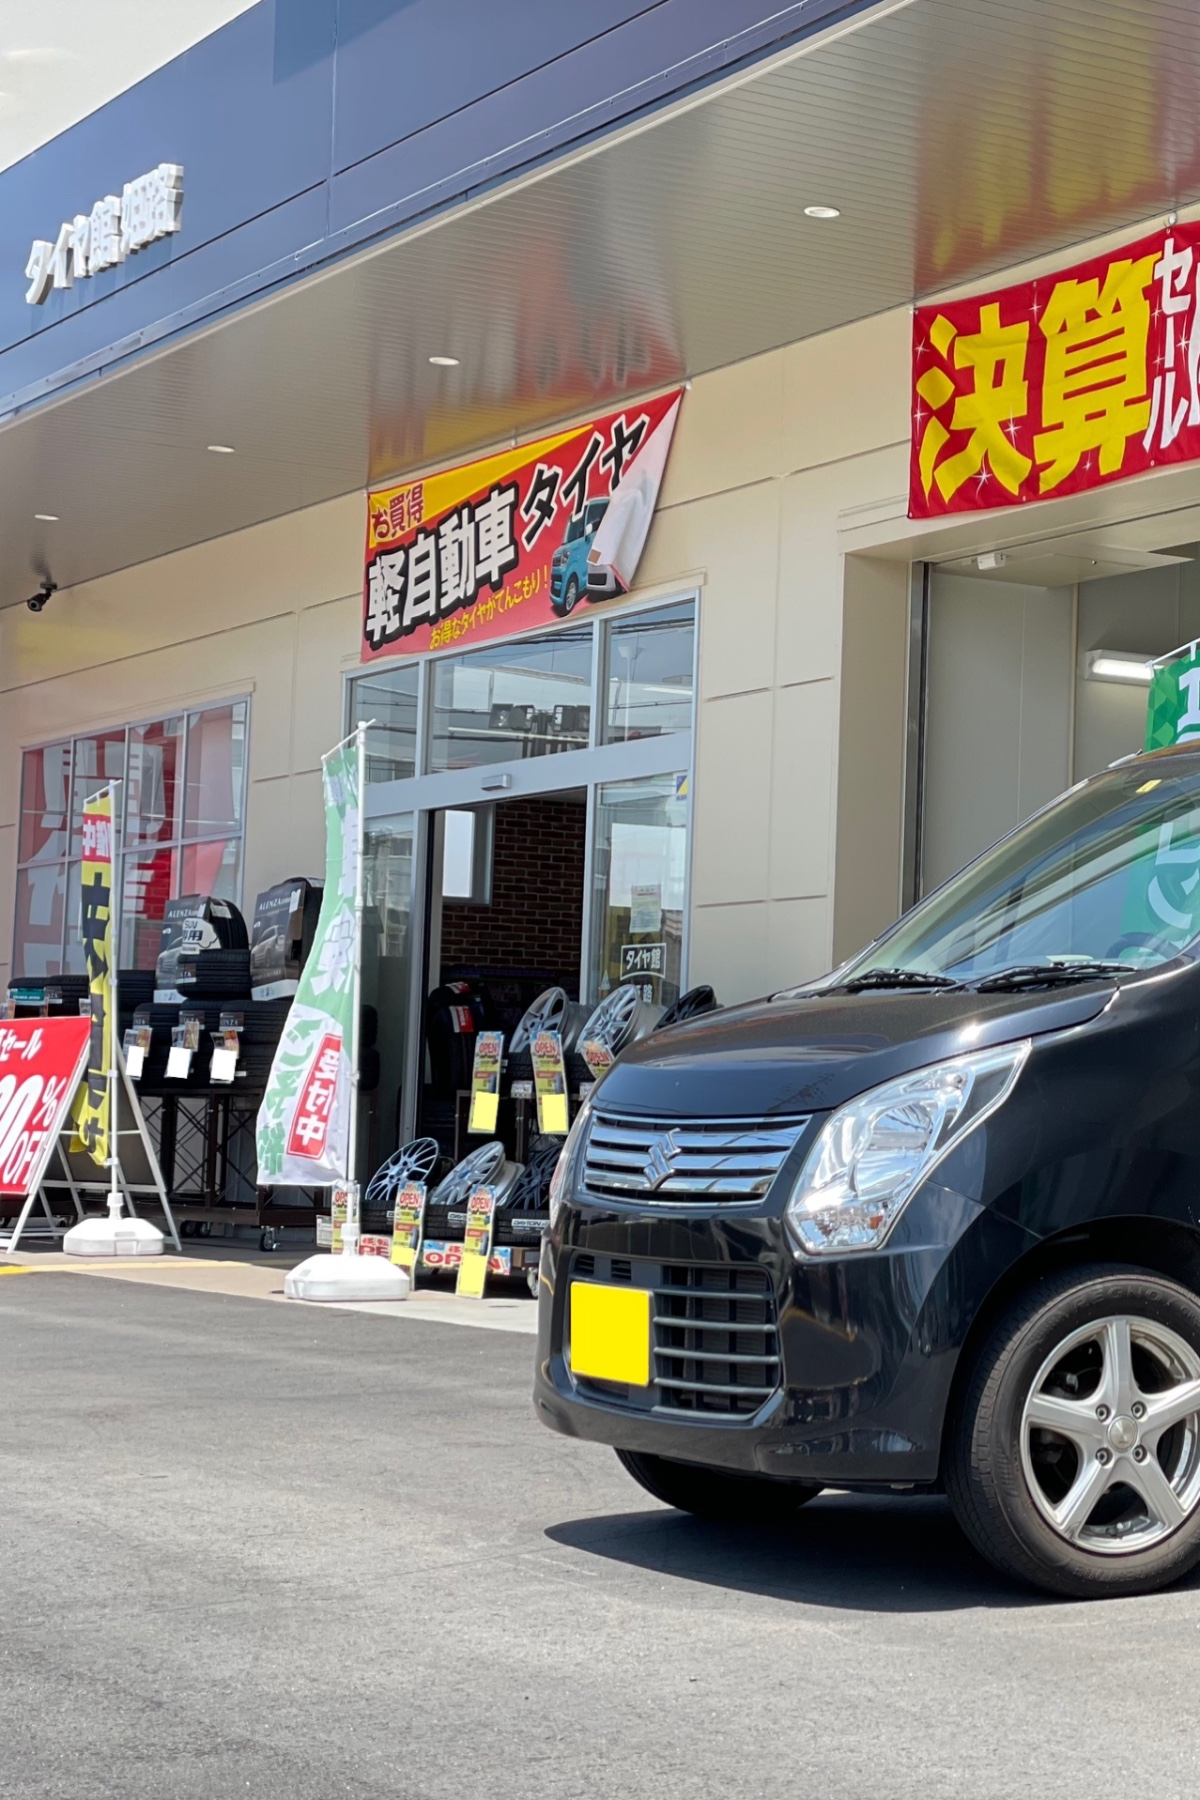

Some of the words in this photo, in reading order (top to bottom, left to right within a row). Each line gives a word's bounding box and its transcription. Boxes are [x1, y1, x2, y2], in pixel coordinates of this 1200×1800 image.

[371, 484, 425, 540] お買得
[185, 920, 198, 929] SUV
[625, 948, 662, 970] タイヤ館
[0, 1028, 44, 1061] セール
